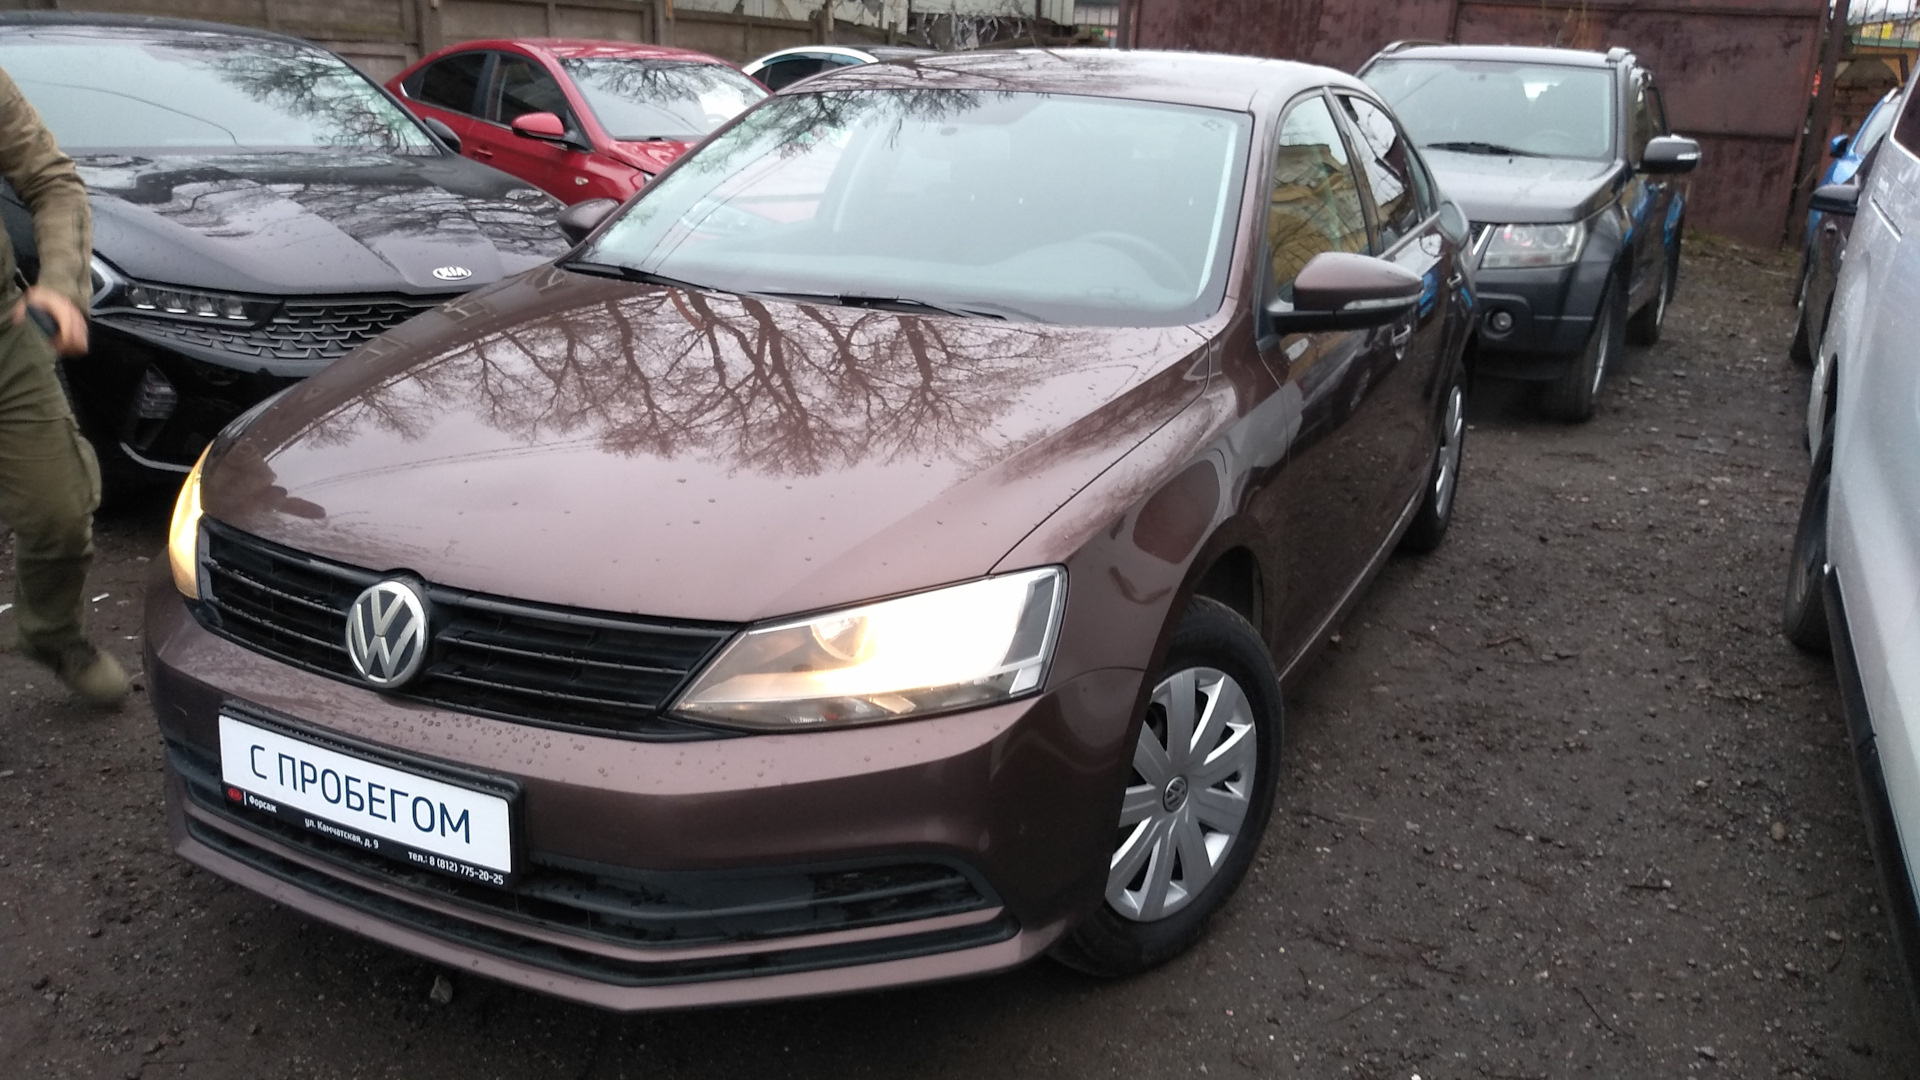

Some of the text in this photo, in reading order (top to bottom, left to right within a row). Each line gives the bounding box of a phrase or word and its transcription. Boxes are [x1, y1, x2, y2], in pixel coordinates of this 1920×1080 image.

[435, 266, 470, 279] KIA
[249, 795, 278, 813] Форсаж
[250, 744, 471, 845] С ПРОБЕГОМ
[304, 817, 380, 849] ул. Камчатская, д. 9
[408, 851, 504, 886] тел.: 8 (812) 775-20-25
